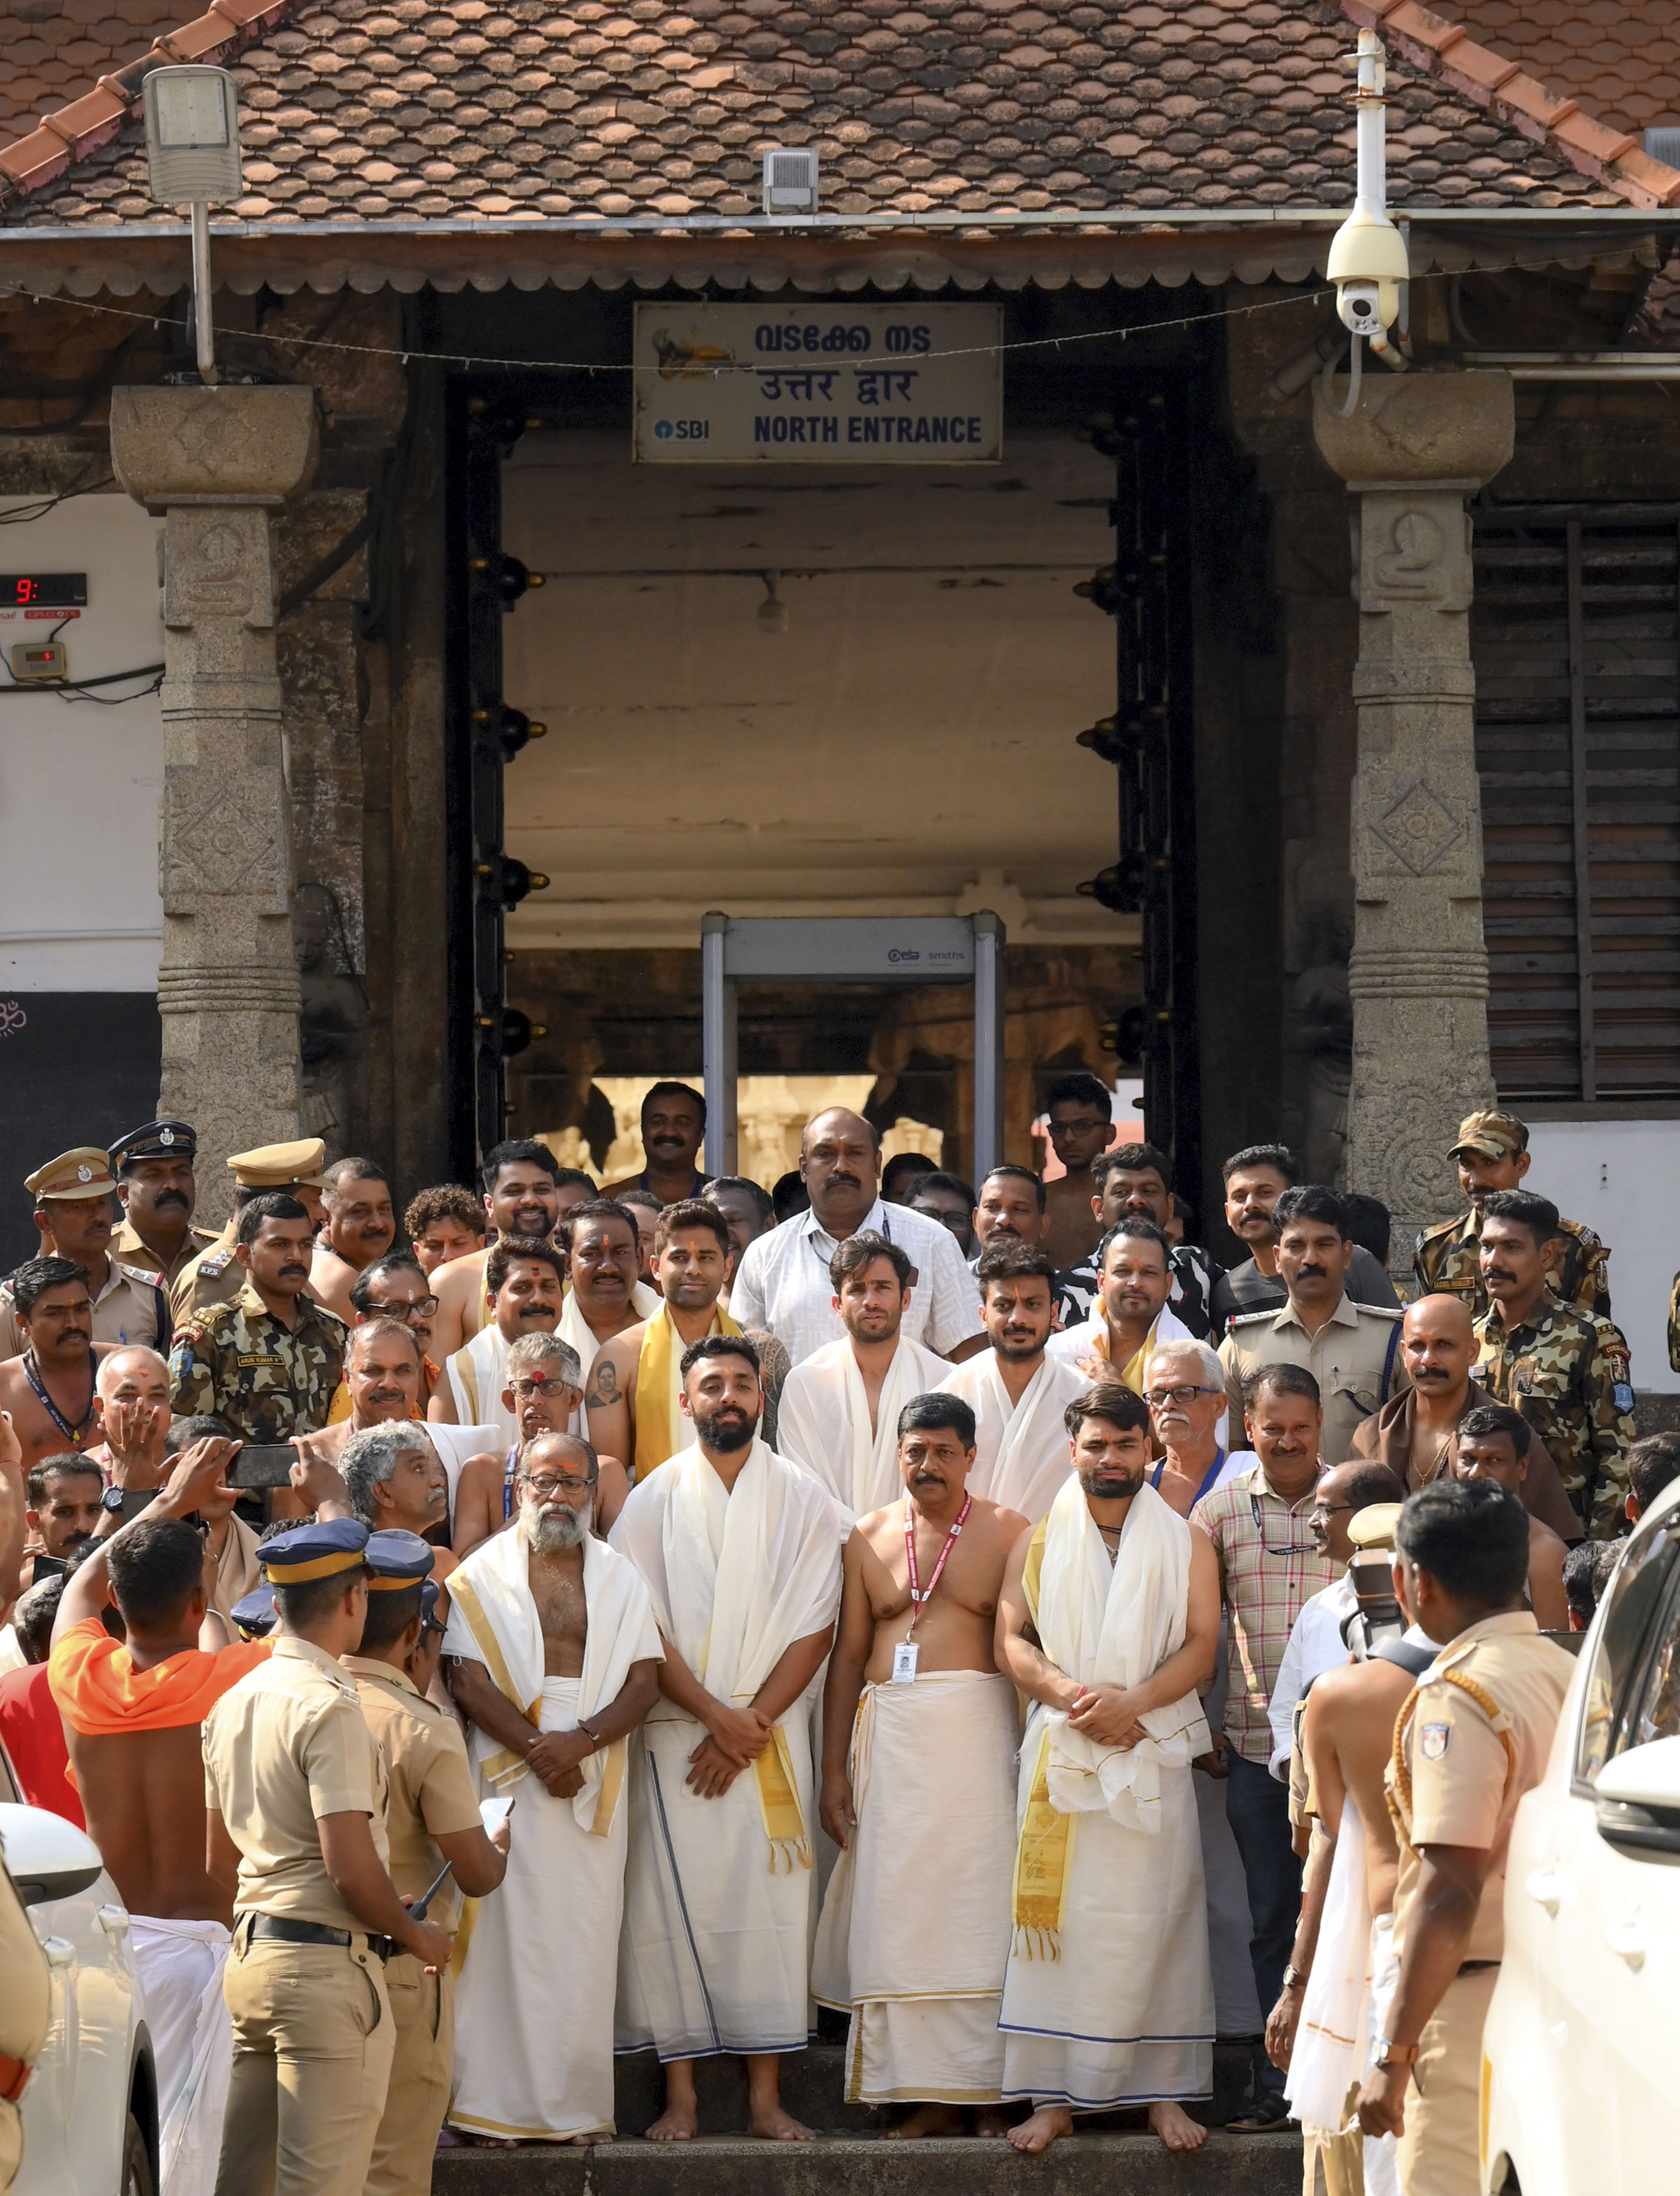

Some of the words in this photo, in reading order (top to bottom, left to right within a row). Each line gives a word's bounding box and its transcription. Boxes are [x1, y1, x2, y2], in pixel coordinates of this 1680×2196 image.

[755, 324, 871, 352] വടക്കേ
[885, 325, 931, 352] നട
[756, 369, 841, 401] उत्तर
[853, 369, 919, 405] द्वार
[676, 420, 709, 439] SBI
[754, 416, 838, 442] NORTH
[848, 416, 981, 443] ENTRANCE
[200, 1265, 219, 1276] KPS
